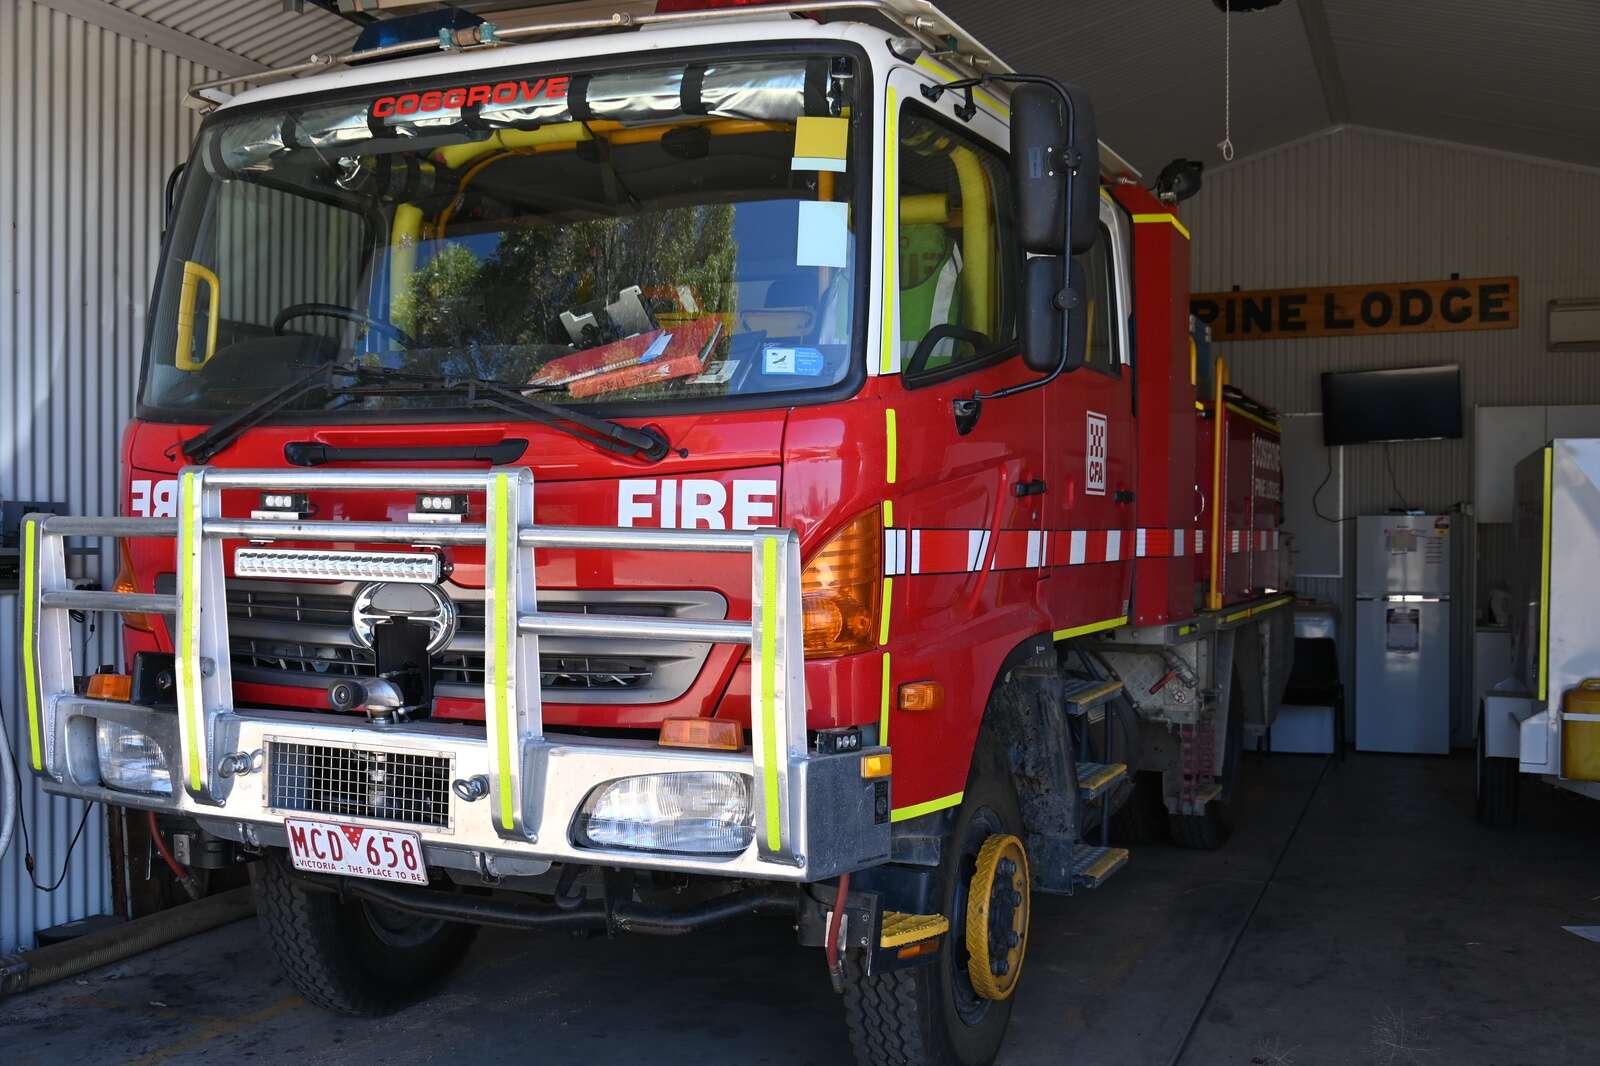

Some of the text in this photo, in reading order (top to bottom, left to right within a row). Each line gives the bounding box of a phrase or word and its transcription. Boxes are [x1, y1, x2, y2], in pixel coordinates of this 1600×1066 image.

[372, 76, 569, 117] COSGROVE
[1190, 284, 1510, 334] PINE LODGE
[1089, 460, 1103, 483] CFA
[617, 479, 777, 530] FIRE
[290, 825, 418, 871] MCD 658
[299, 860, 337, 871] VICTORIA
[348, 864, 364, 873] THE
[367, 867, 393, 878] PLACE
[396, 871, 407, 880] TO
